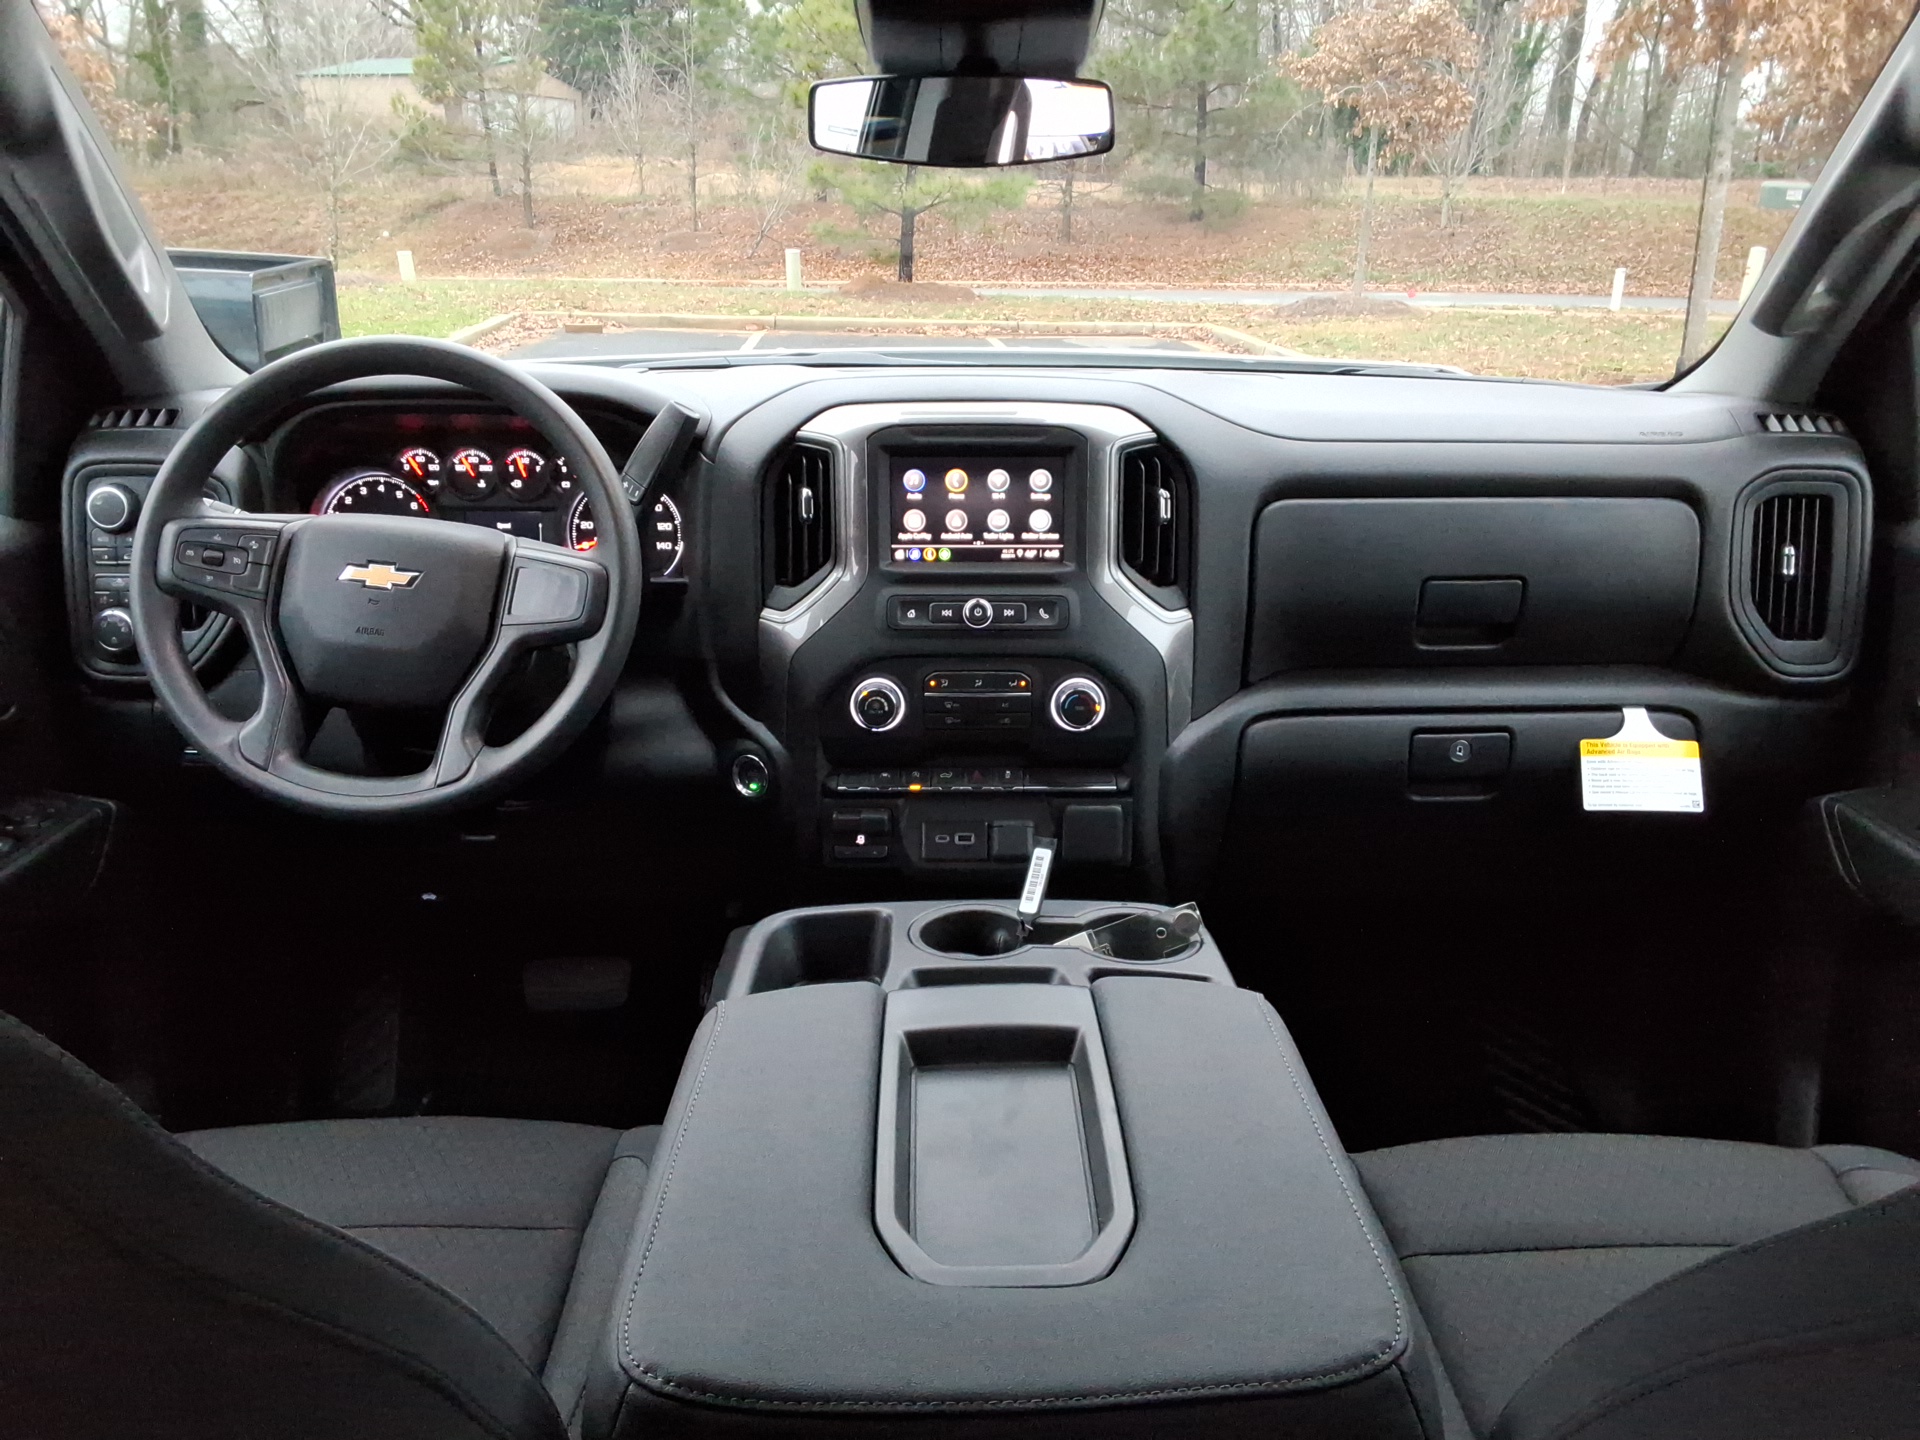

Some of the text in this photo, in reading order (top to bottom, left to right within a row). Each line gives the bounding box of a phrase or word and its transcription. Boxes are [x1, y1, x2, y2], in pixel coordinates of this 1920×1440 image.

[403, 463, 410, 471] 0
[359, 486, 367, 495] 3
[377, 484, 385, 493] 4
[395, 490, 403, 499] 5
[344, 496, 352, 505] 2
[410, 501, 418, 510] 6
[580, 521, 594, 529] 20
[656, 522, 672, 531] 120
[656, 542, 672, 550] 140
[355, 626, 385, 637] AIRBAG
